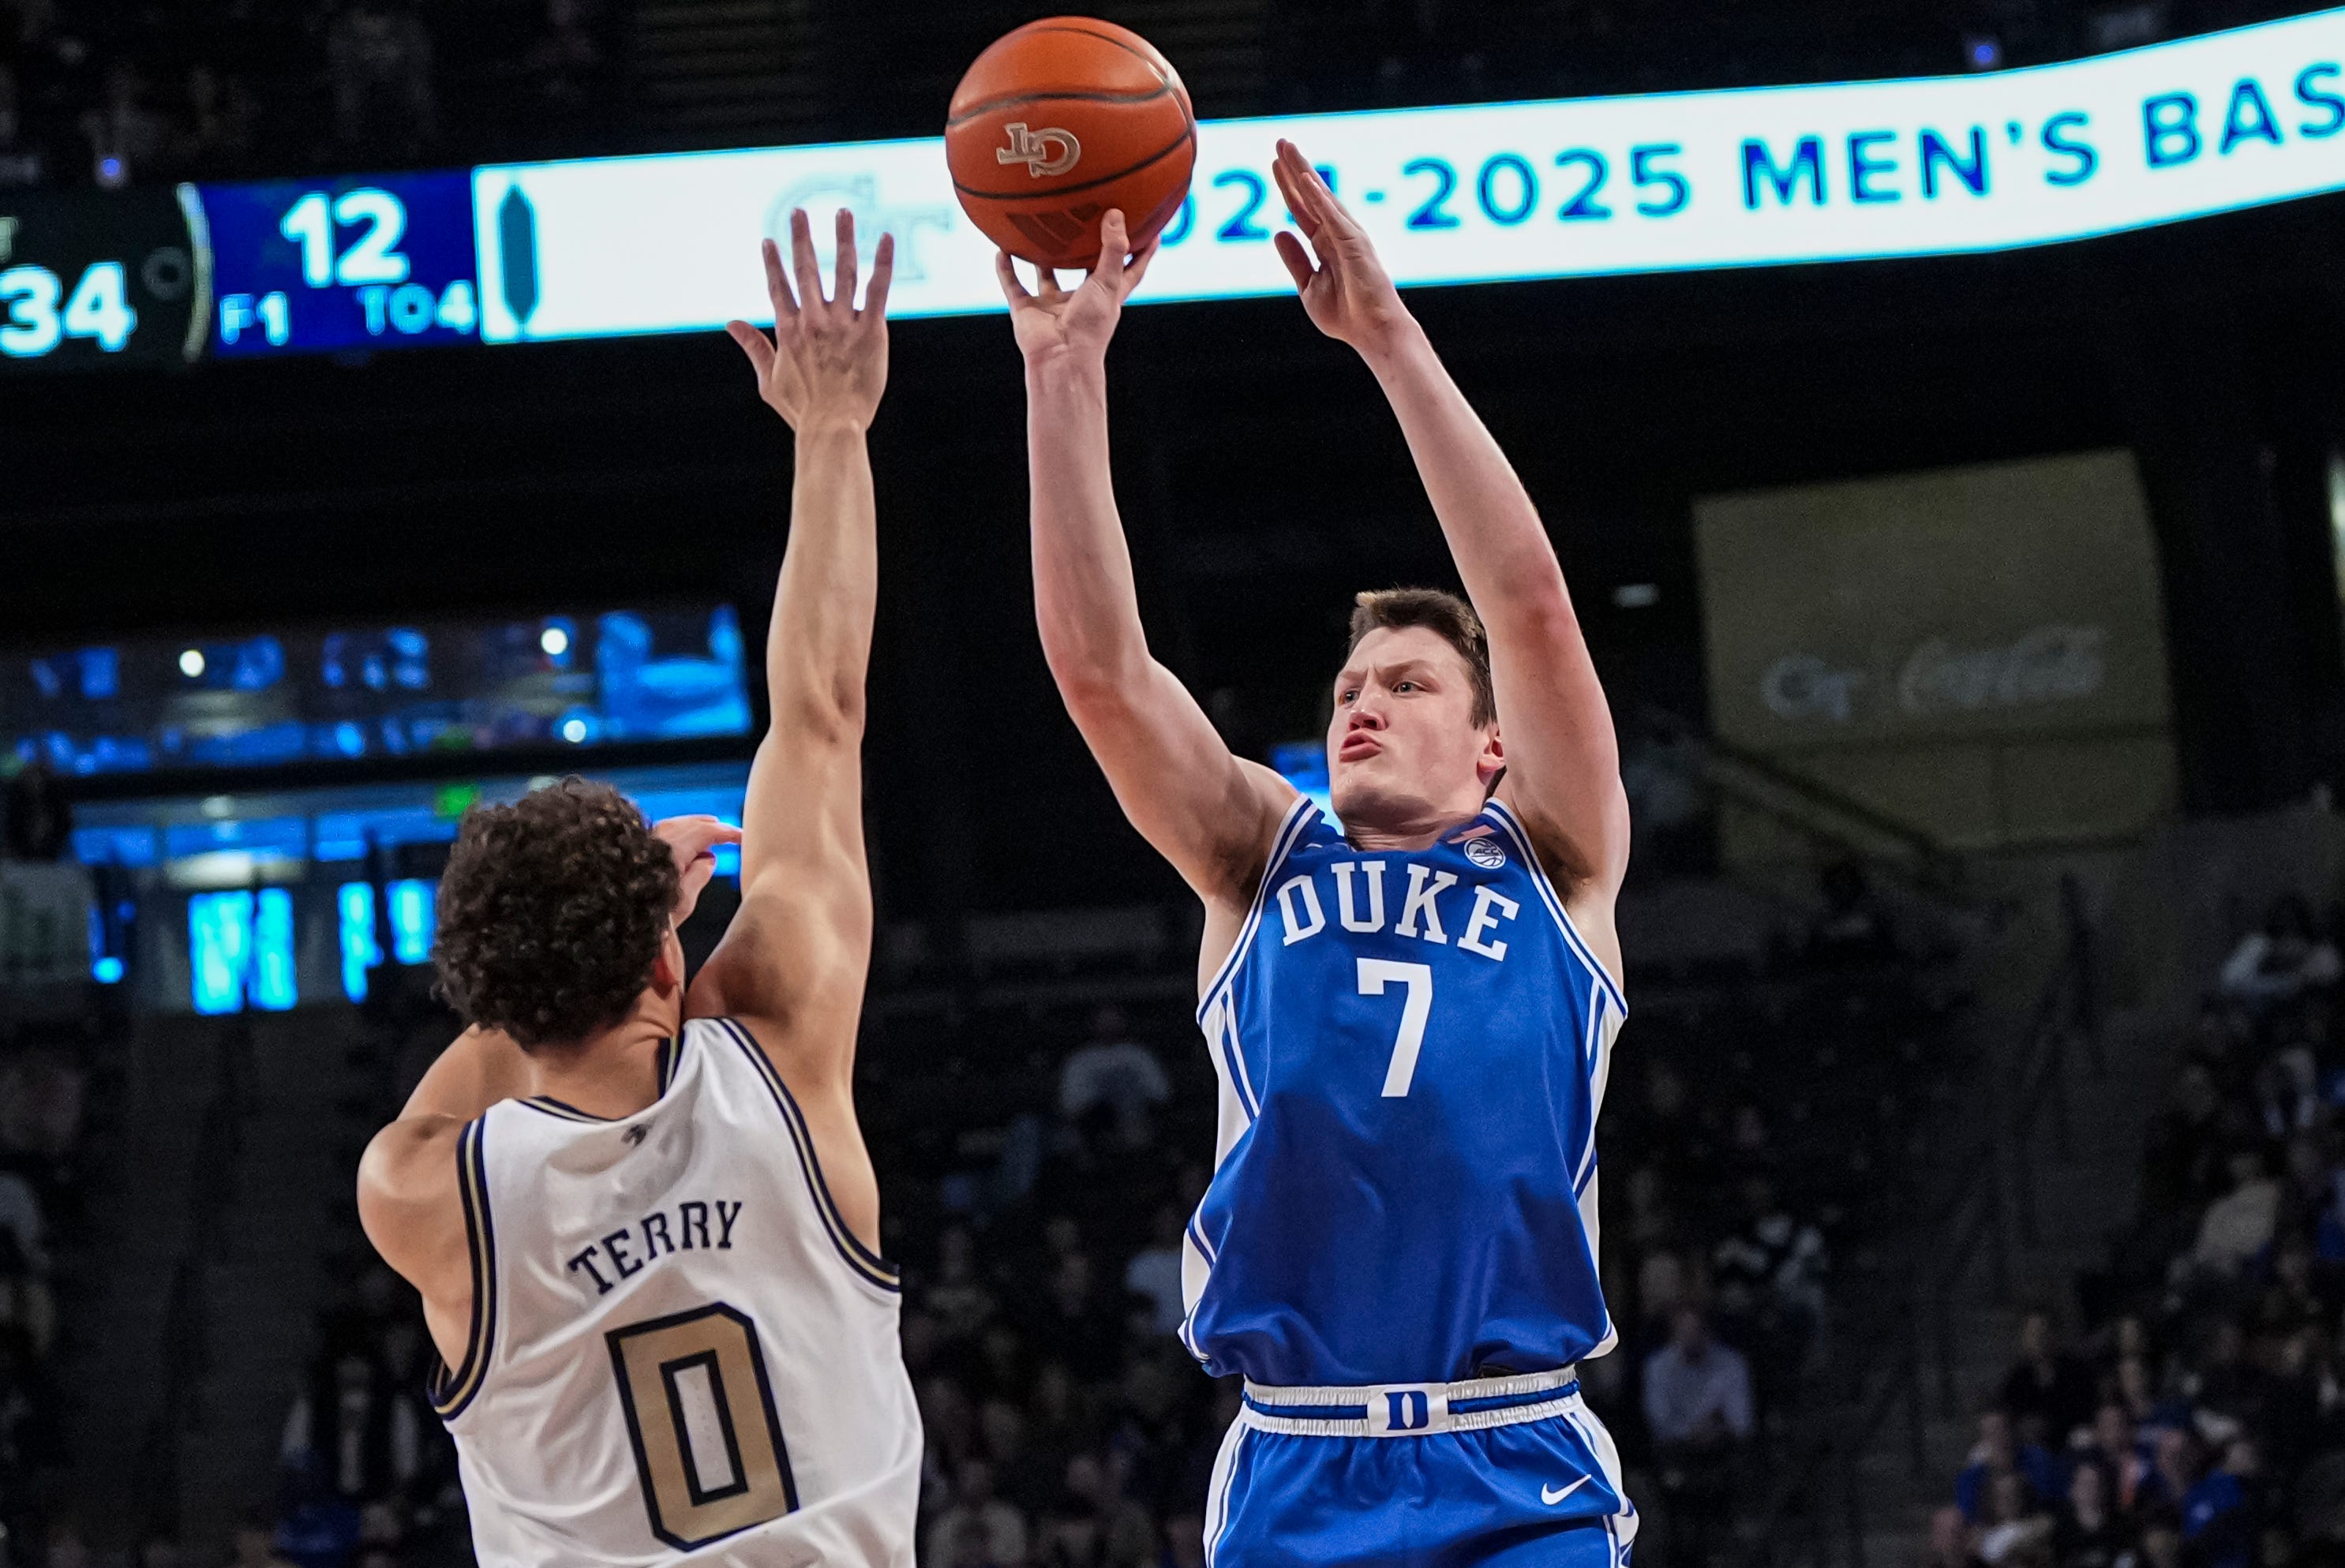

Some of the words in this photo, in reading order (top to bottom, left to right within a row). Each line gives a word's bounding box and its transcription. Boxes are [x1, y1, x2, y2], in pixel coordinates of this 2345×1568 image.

[1740, 111, 2099, 208] MEN'S
[2142, 62, 2345, 169] BAS
[280, 188, 410, 287] 12
[0, 262, 137, 357] 34
[1474, 848, 1500, 856] ACC
[1276, 860, 1519, 962] DUKE
[1356, 957, 1433, 1098] 7
[567, 1200, 742, 1295] TERRY
[605, 1301, 800, 1552] 0
[1384, 1391, 1428, 1430] D
